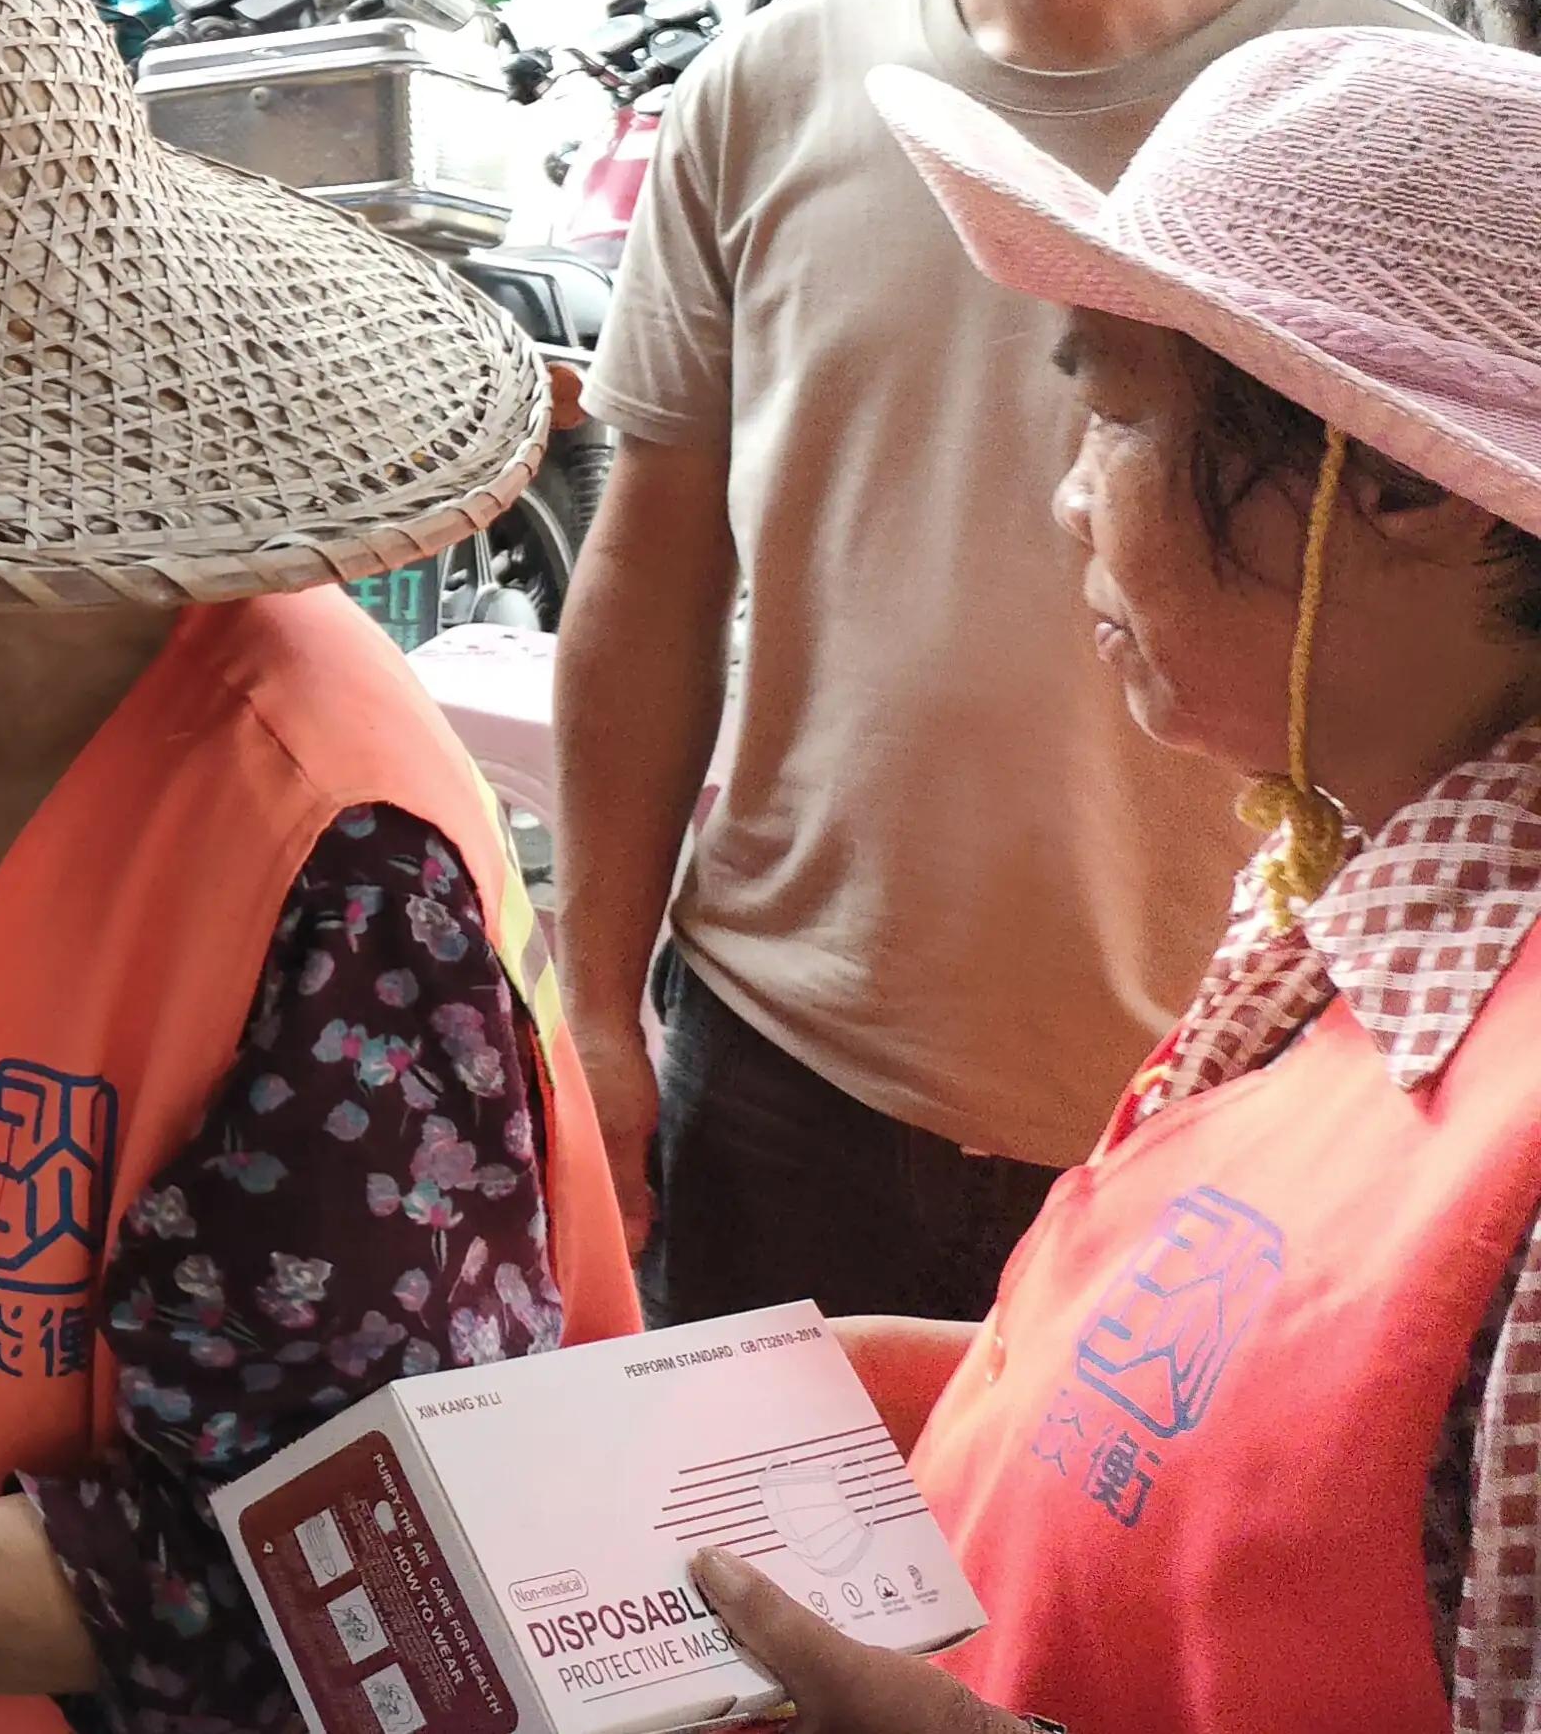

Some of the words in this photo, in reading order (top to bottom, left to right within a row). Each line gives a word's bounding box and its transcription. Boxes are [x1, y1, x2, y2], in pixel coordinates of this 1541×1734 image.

[623, 1357, 677, 1379] PERFORM
[416, 1403, 440, 1420] XIN
[437, 1397, 475, 1416] KANG
[474, 1393, 489, 1409] XI
[488, 1391, 503, 1406] LI
[373, 1452, 404, 1506] PURIFY
[398, 1508, 418, 1539] THE
[428, 1576, 456, 1618] CARE
[450, 1619, 471, 1653] FOR
[466, 1652, 503, 1716] HEALTH
[514, 1575, 583, 1605] Non-medical
[392, 1545, 422, 1592] HOW
[417, 1595, 435, 1623] TO
[430, 1625, 465, 1686] WEAR
[557, 1639, 684, 1694] PROTECTIVE
